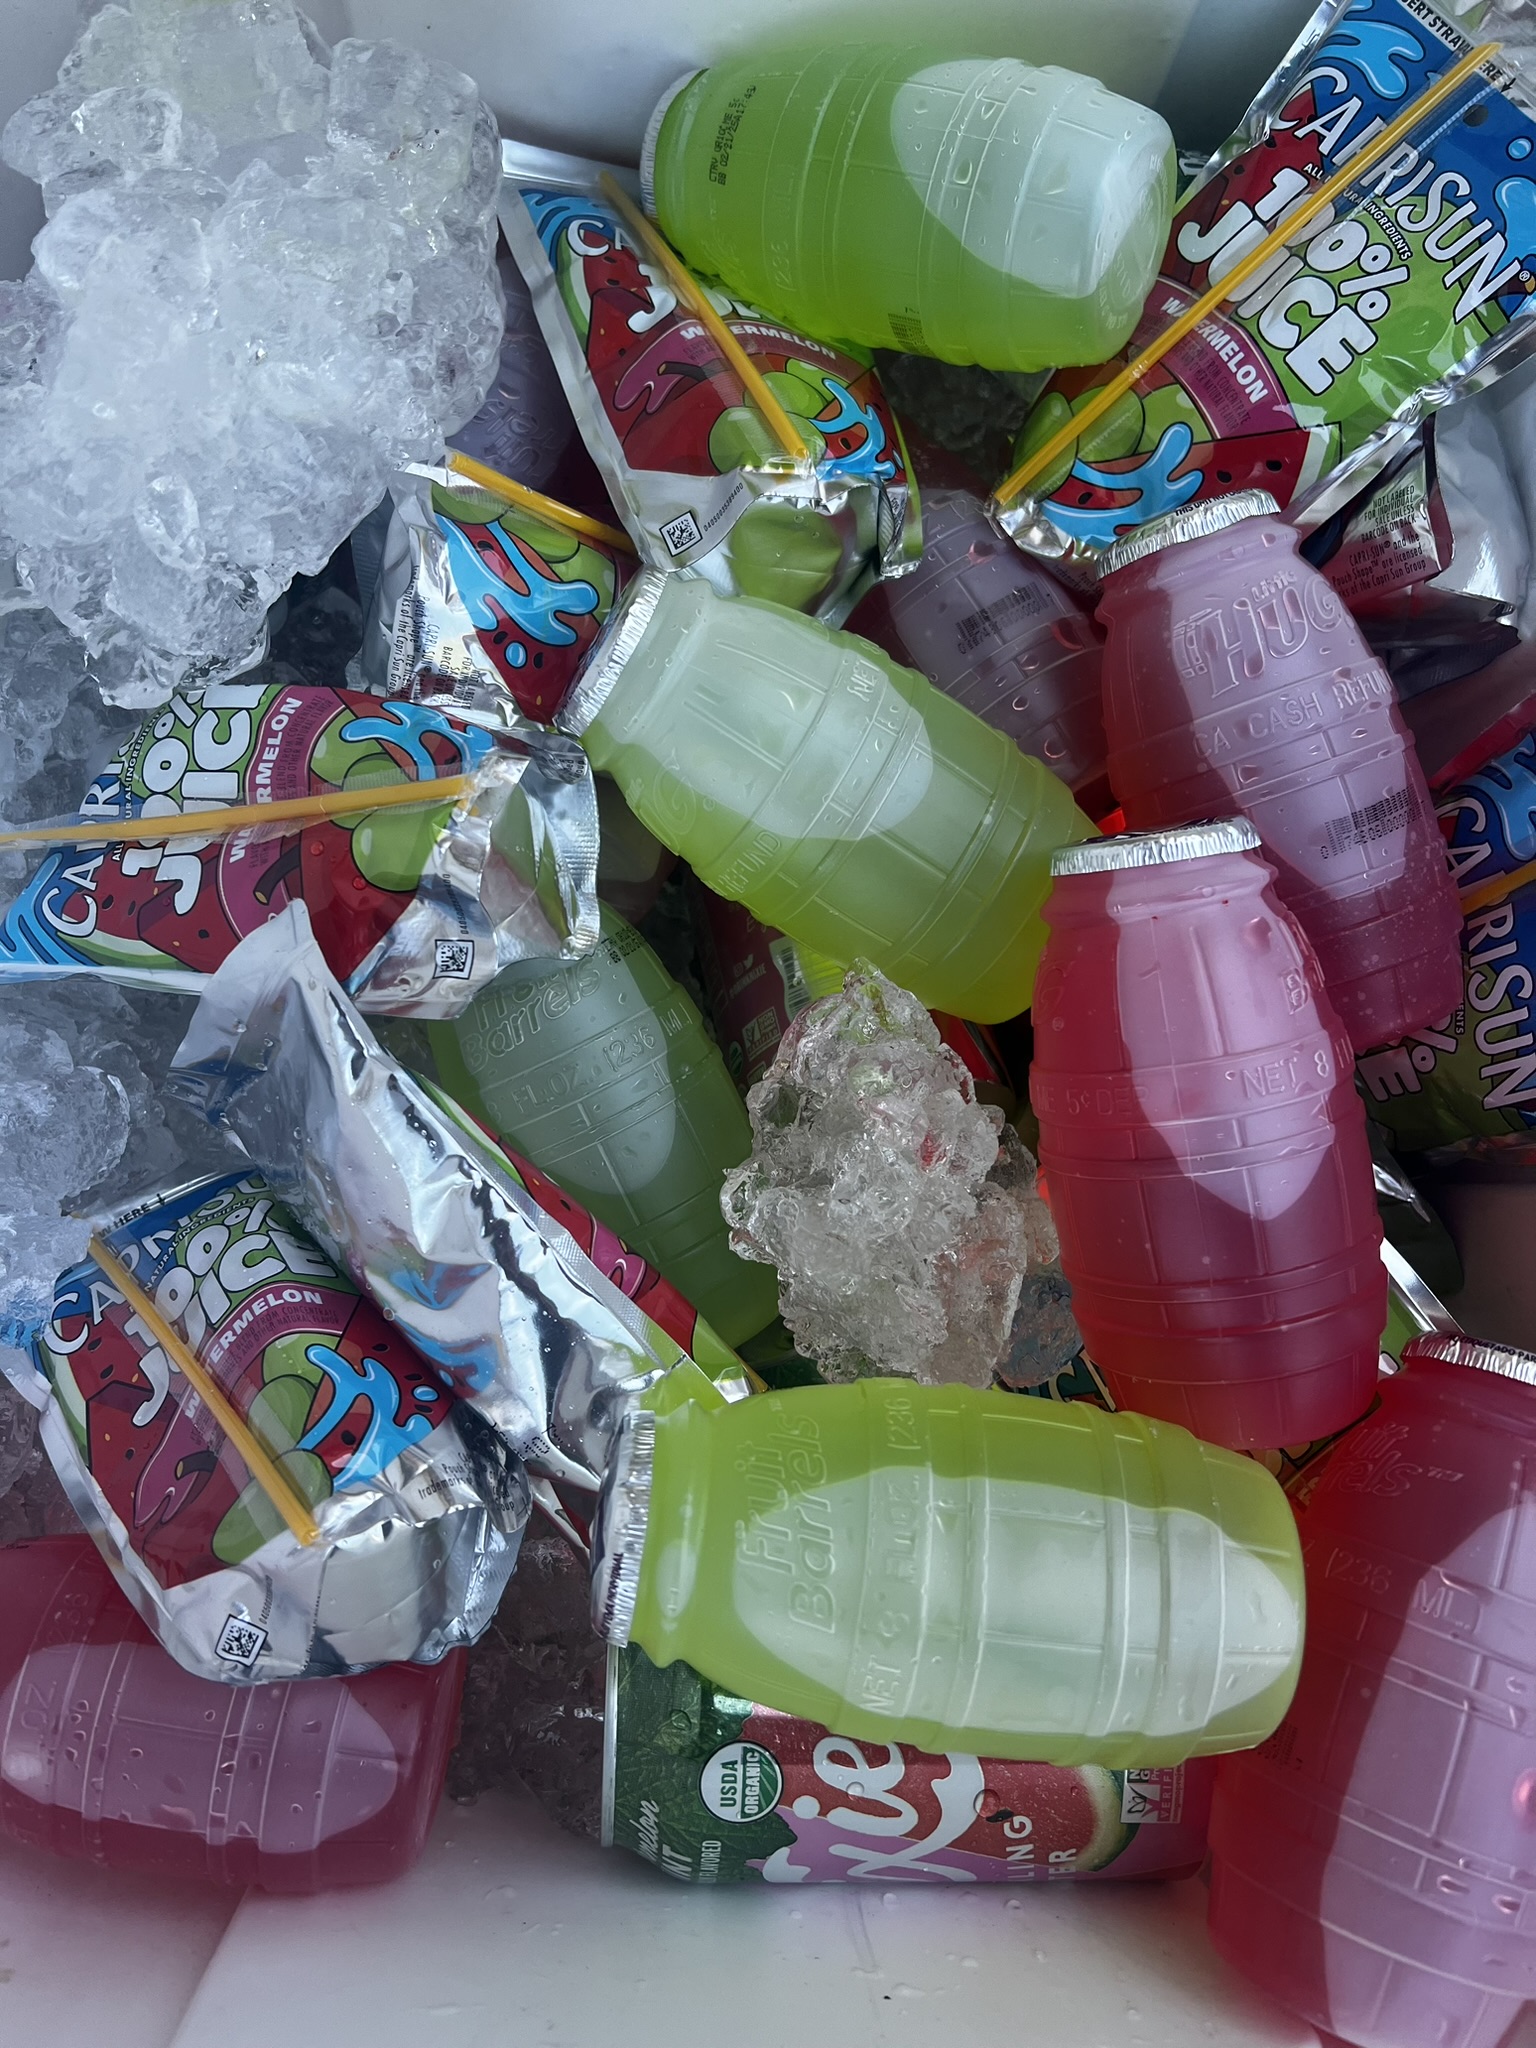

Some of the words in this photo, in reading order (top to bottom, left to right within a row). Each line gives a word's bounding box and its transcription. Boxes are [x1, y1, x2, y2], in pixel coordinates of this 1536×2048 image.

[1403, 0, 1434, 20] ERT
[1478, 60, 1504, 81] ERE
[1303, 162, 1324, 180] ALL
[1255, 168, 1410, 322] 100%
[1366, 202, 1412, 260] INGREDIENTS
[1178, 201, 1378, 395] JUICE
[679, 324, 837, 360] WERMELON
[1160, 297, 1269, 404] WAERMELON
[1173, 505, 1194, 517] THIS
[1364, 510, 1377, 521] FOR
[1377, 496, 1414, 517] INDIVIDUAL
[1373, 497, 1386, 508] NOT
[1386, 485, 1415, 505] LABELED
[1361, 526, 1389, 543] BARCODE
[1390, 521, 1400, 532] ON
[1400, 514, 1416, 529] BACK
[1375, 515, 1391, 527] SALE
[1391, 504, 1415, 522] UNLESS
[1381, 557, 1392, 570] are
[1394, 544, 1423, 565] licensed
[1392, 537, 1406, 550] and
[1407, 532, 1420, 546] the
[1360, 578, 1371, 592] the
[1371, 570, 1390, 587] Capri
[1392, 566, 1404, 580] Sun
[1404, 559, 1427, 576] Group
[398, 618, 408, 632] the
[394, 634, 406, 655] Capri
[405, 653, 416, 670] are
[391, 658, 402, 671] Sun
[1249, 691, 1324, 739] CASH
[1333, 668, 1394, 709] REFUN
[229, 696, 303, 864] WARMELON
[1241, 1056, 1299, 1097] NET
[1313, 1050, 1331, 1079] 8
[113, 1203, 152, 1229] HERE
[132, 1230, 339, 1429] JUICE
[184, 1288, 324, 1420] WTERMELON
[1518, 1351, 1536, 1362] PAR
[858, 1654, 902, 1717] NET
[719, 1759, 739, 1808] USDA
[743, 1750, 762, 1815] ORGANIC
[1160, 1769, 1174, 1819] VERIFI
[699, 1839, 722, 1879] FLAVORED
